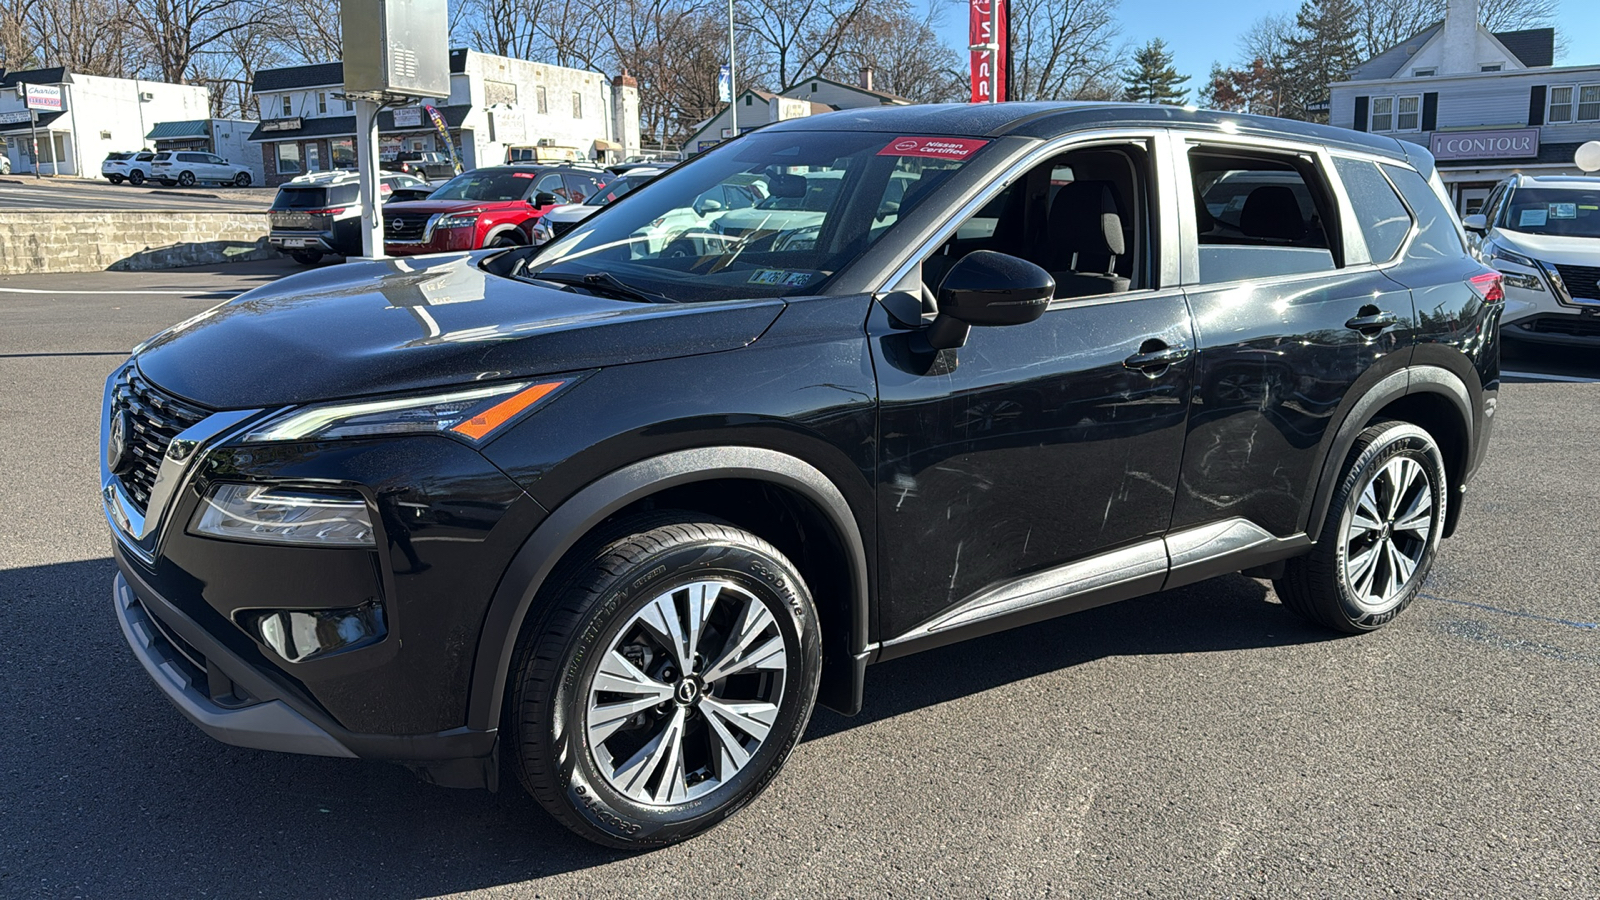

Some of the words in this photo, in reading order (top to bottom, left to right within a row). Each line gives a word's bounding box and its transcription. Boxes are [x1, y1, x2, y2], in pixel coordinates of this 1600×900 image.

[920, 146, 969, 155] Certified
[1447, 137, 1530, 152] CONTOUR
[751, 561, 802, 616] GeoDrive
[575, 785, 642, 835] GeoDrive
